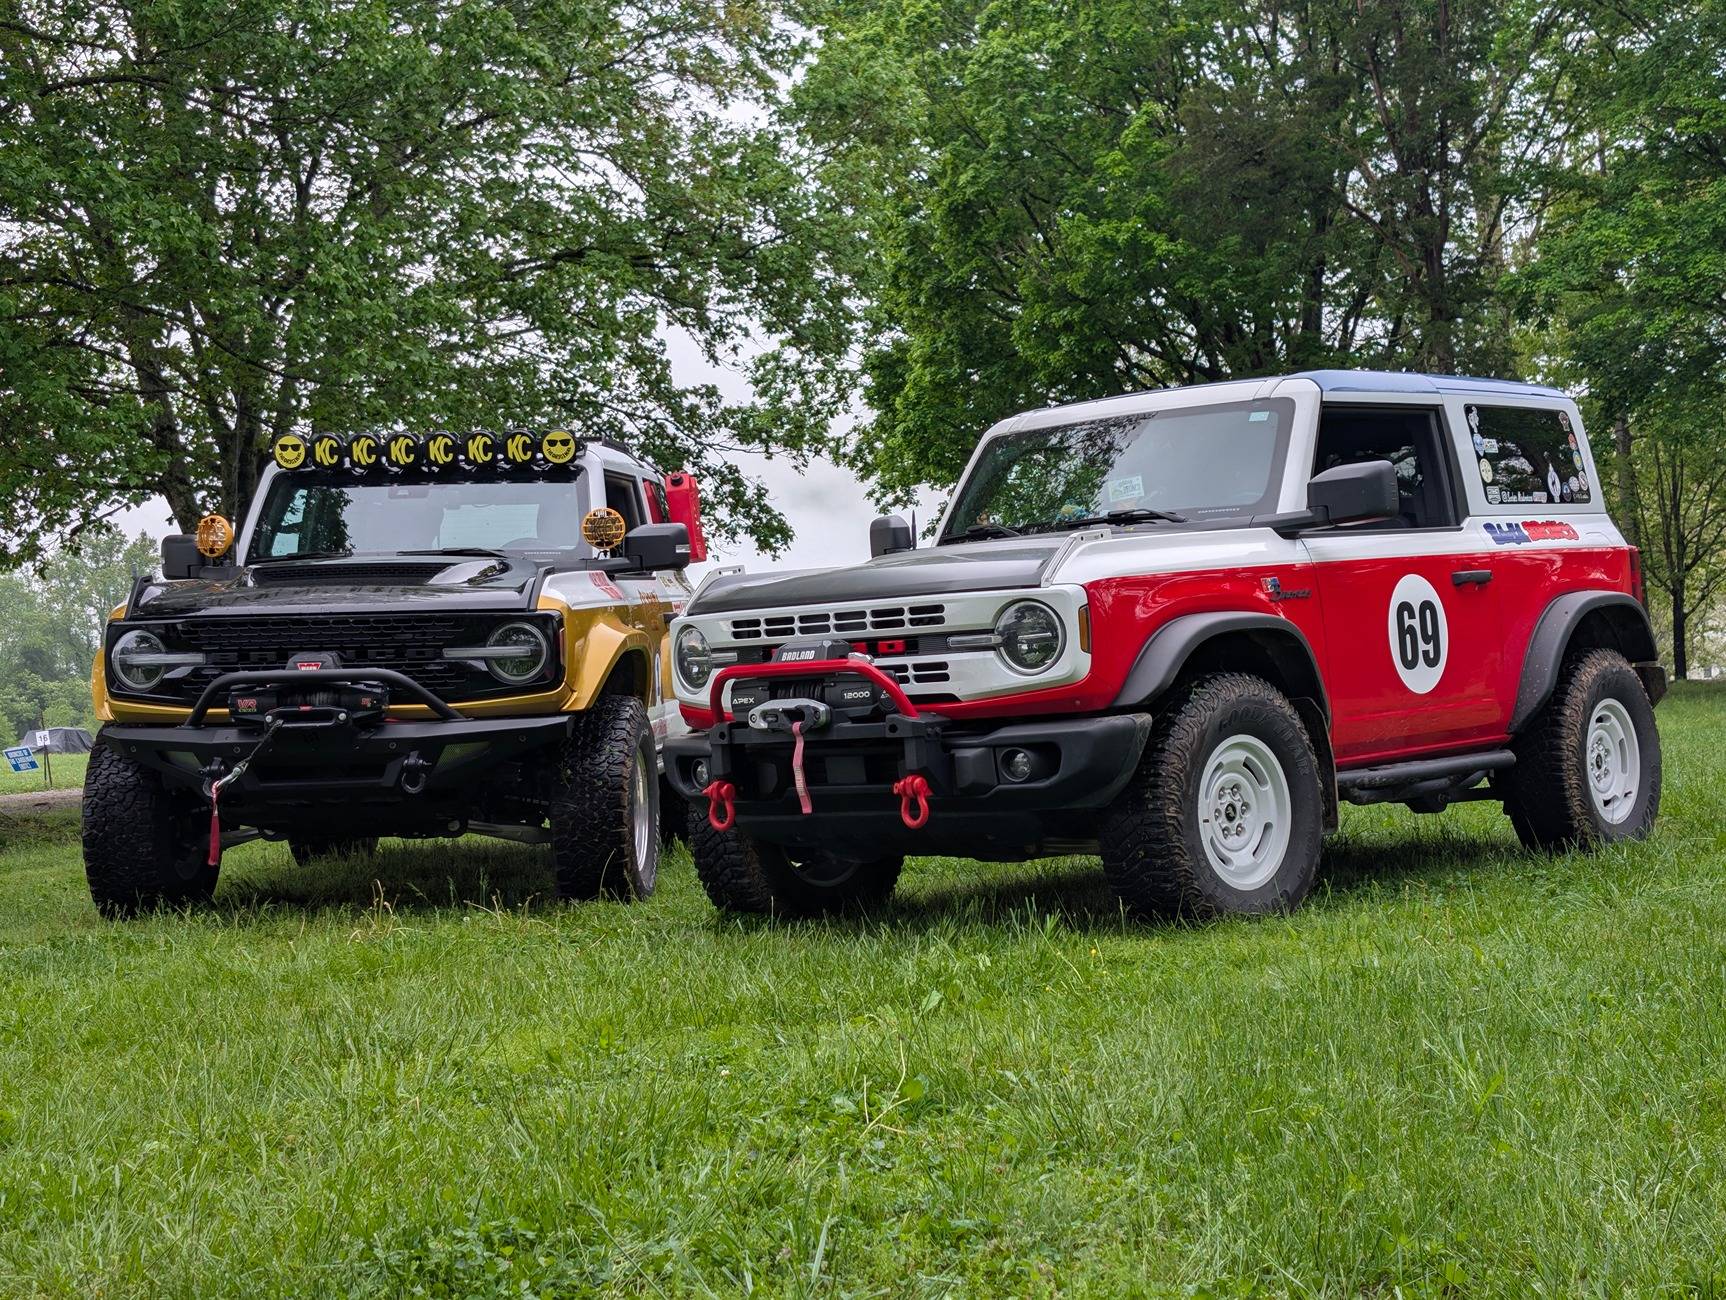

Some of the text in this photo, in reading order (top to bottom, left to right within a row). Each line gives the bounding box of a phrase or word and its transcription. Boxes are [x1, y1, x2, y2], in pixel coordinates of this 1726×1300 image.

[315, 437, 339, 466] KC
[352, 437, 376, 465] KC
[390, 436, 415, 465] KC
[428, 436, 454, 464] KC
[467, 435, 493, 463] KC
[507, 434, 532, 463] KC
[1396, 599, 1441, 671] 69
[781, 650, 815, 662] BADLAND
[732, 697, 755, 705] APEX
[843, 691, 871, 700] 12000
